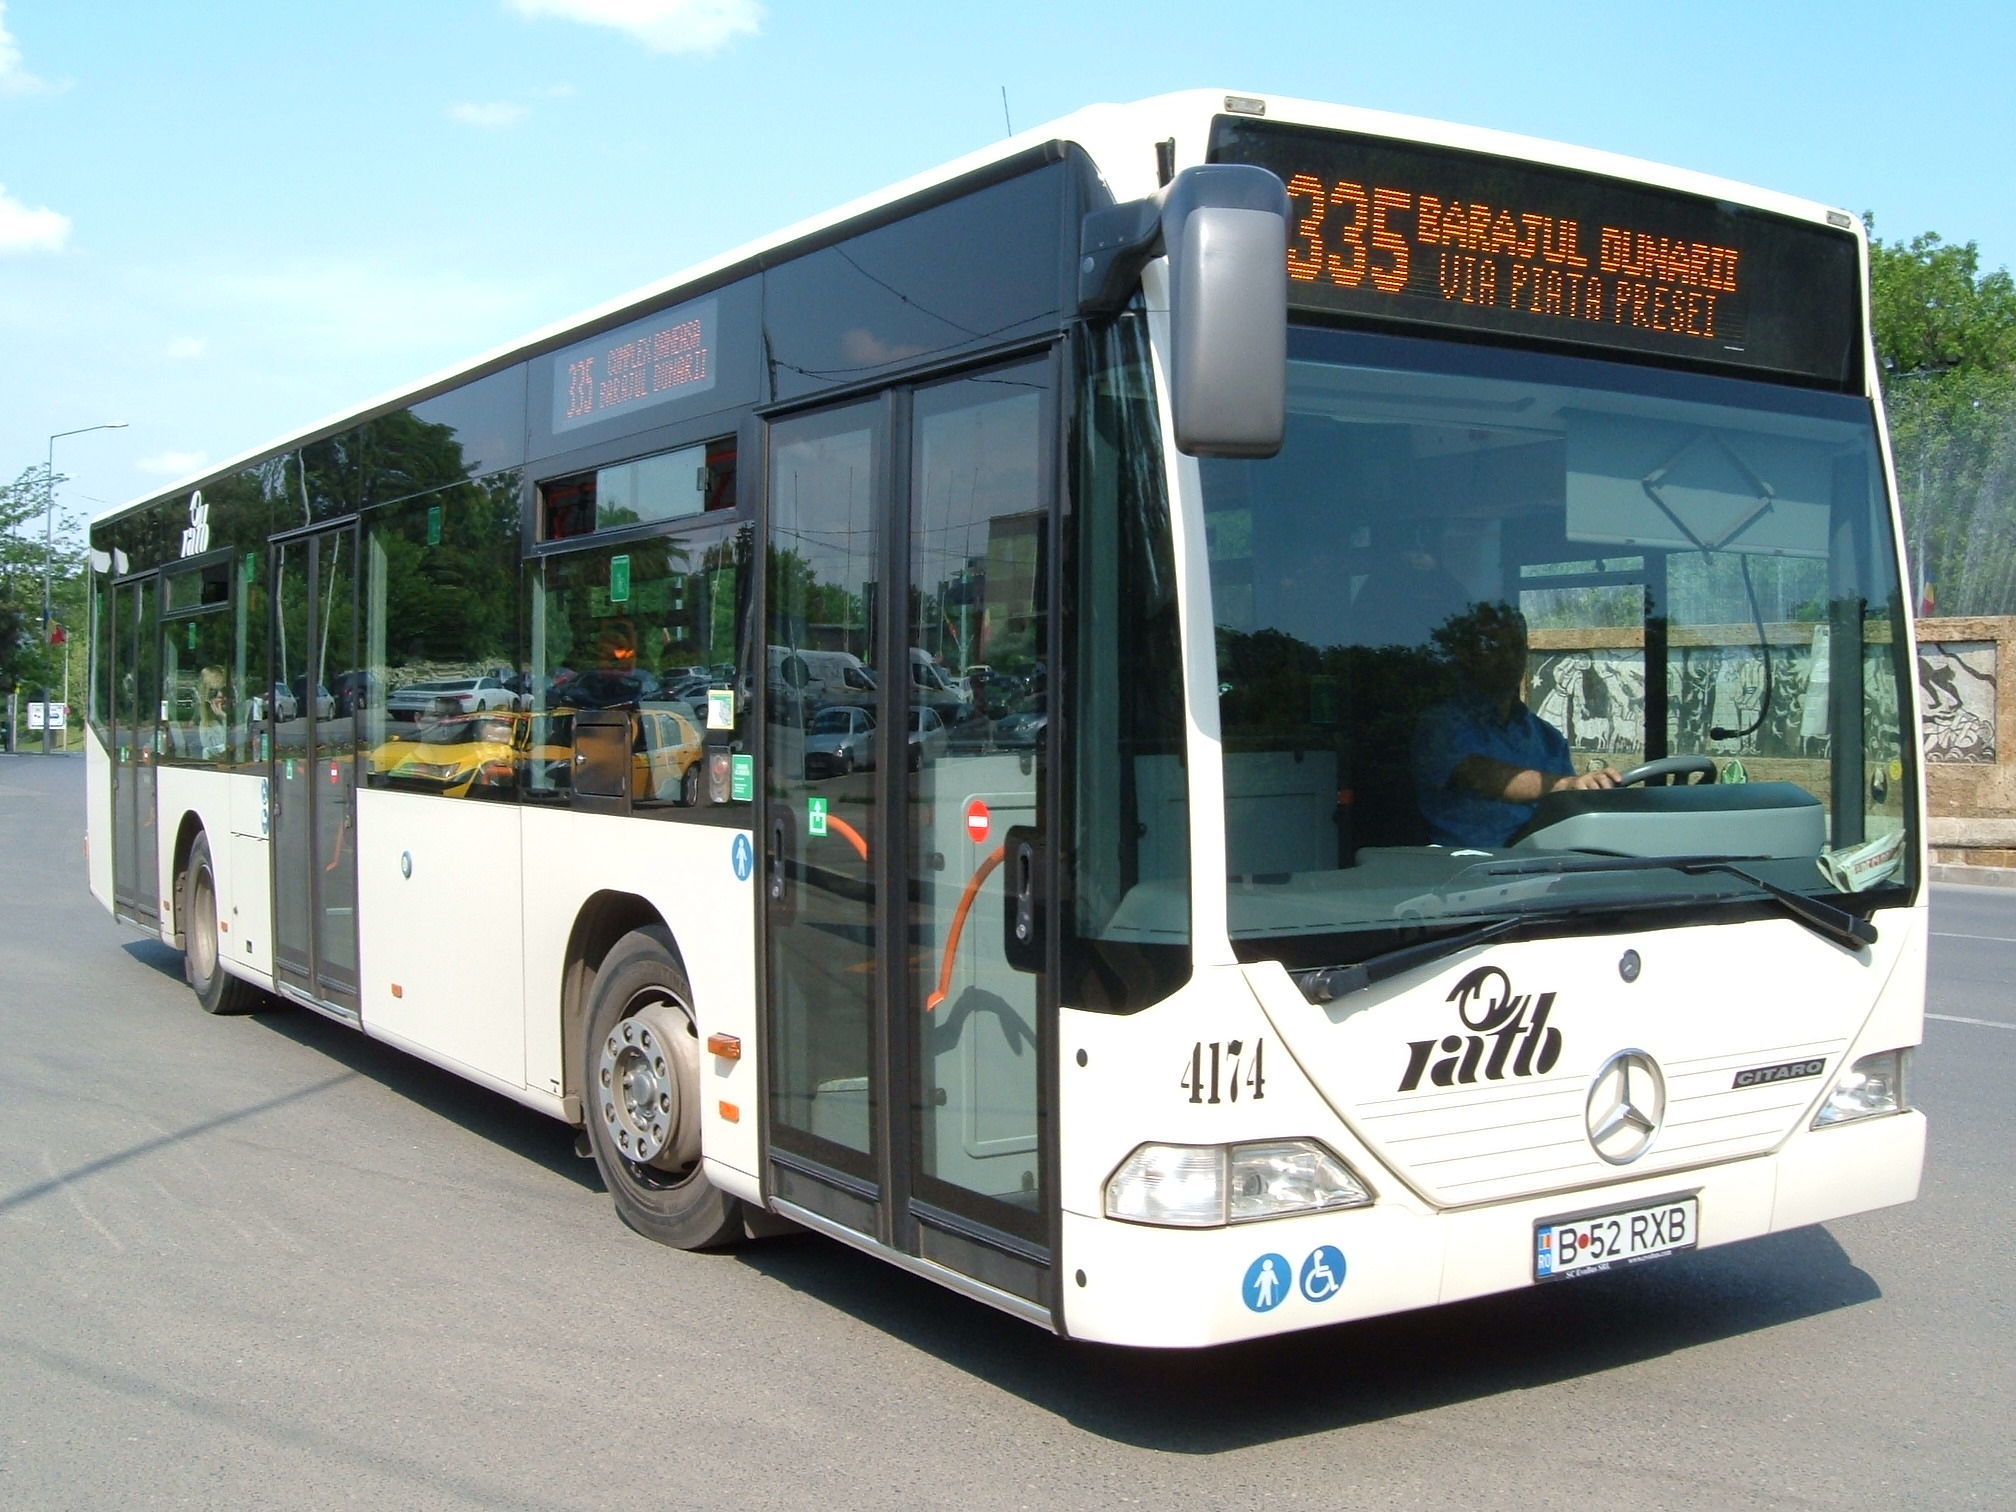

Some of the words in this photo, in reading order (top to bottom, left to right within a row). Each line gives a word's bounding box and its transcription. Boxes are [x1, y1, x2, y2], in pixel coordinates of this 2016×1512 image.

[1287, 173, 1412, 293] 335
[1418, 195, 1588, 268] BARAJUL
[1600, 227, 1739, 293] DUNARII
[1440, 252, 1497, 306] VIA
[1510, 263, 1602, 323] PIATA
[1615, 279, 1717, 338] PRESEI
[1180, 1037, 1266, 1104] 4174
[1737, 1060, 1823, 1086] CITARO
[1631, 1207, 1687, 1252] RXB
